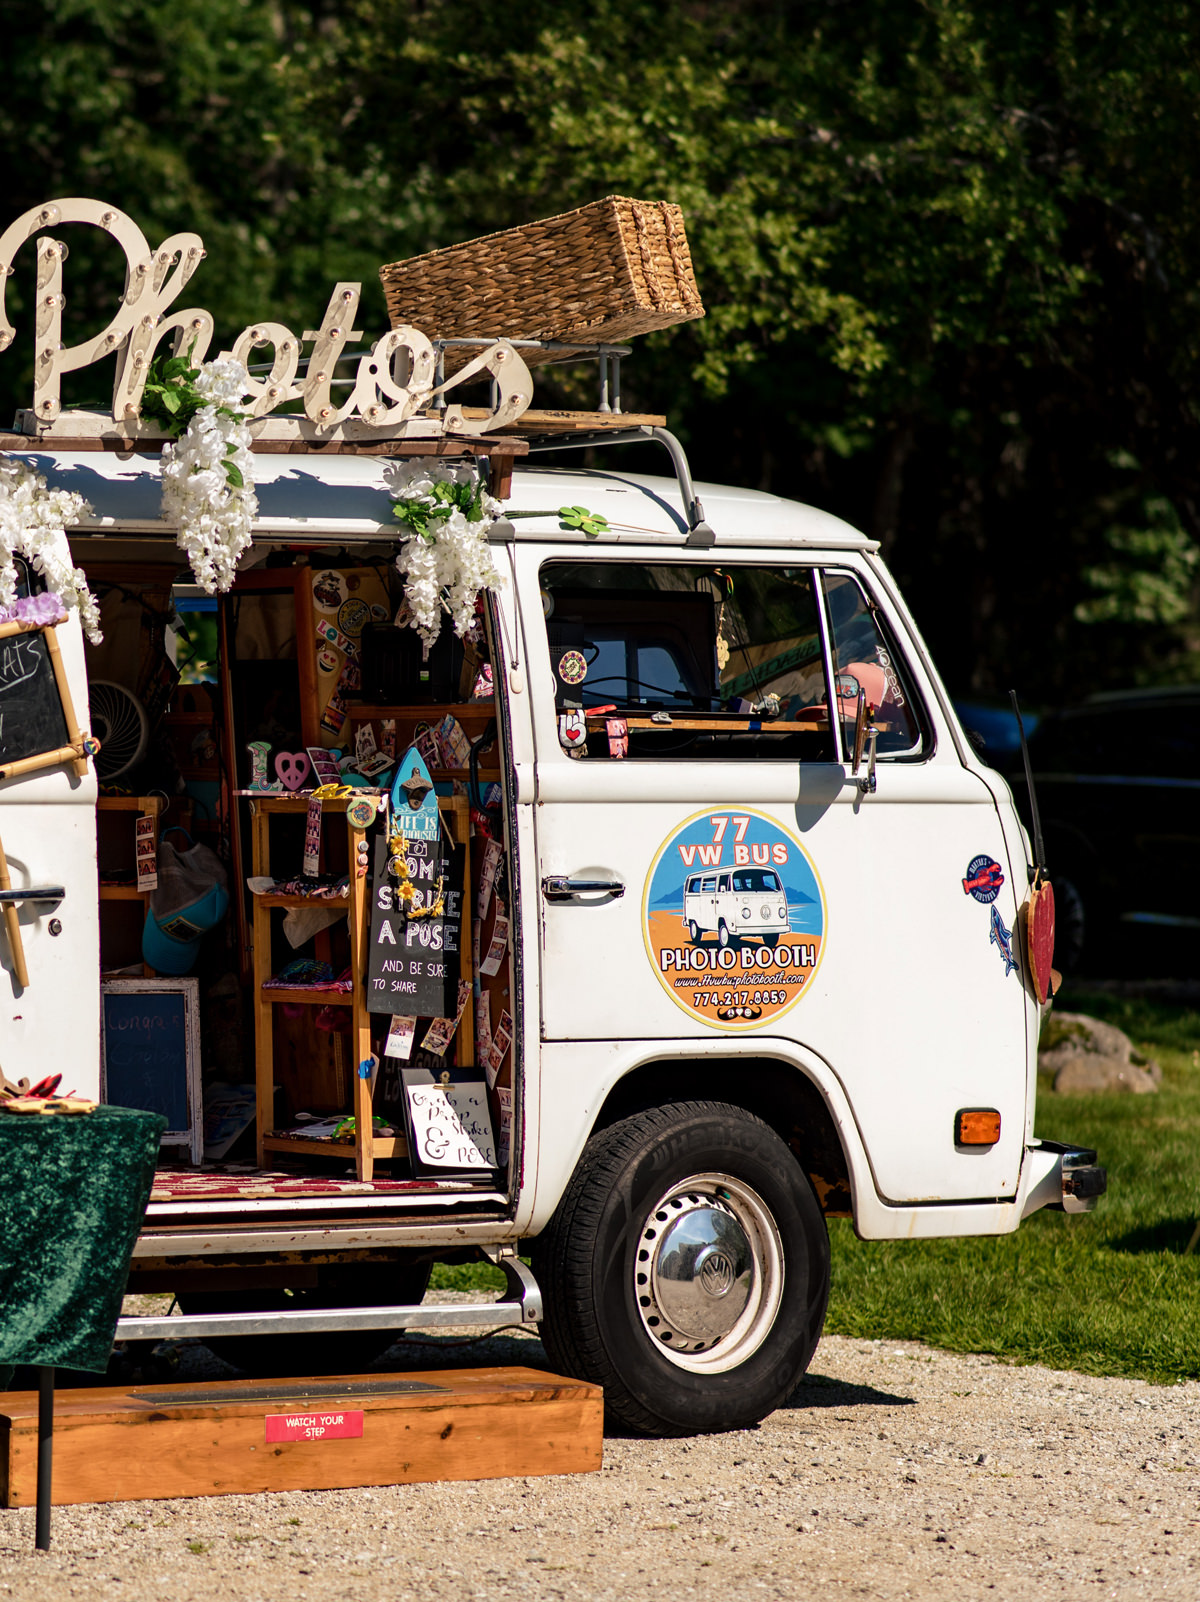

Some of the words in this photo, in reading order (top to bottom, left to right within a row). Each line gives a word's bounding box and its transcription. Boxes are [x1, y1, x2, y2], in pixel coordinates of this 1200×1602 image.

[317, 620, 356, 656] LOVE
[393, 815, 418, 830] IFE
[424, 816, 437, 830] IS
[711, 816, 750, 843] 77
[392, 829, 437, 841] SRIOUSLY
[678, 844, 723, 867] VW
[734, 843, 789, 866] BUS
[378, 920, 397, 945] A
[406, 922, 459, 951] POSE
[660, 947, 737, 971] PHOTO
[740, 945, 816, 970] BOOTH
[382, 960, 404, 973] AND
[410, 961, 423, 975] BE
[427, 963, 449, 978] SURE
[372, 978, 386, 990] TO
[391, 981, 417, 994] SHARE
[674, 970, 805, 989] www.77vwbusphotobooth.com
[693, 991, 787, 1007] 774.217.8859
[425, 1126, 450, 1160] &
[286, 1417, 316, 1428] WATCH
[320, 1415, 344, 1425] YOUR
[305, 1427, 325, 1437] STEP
